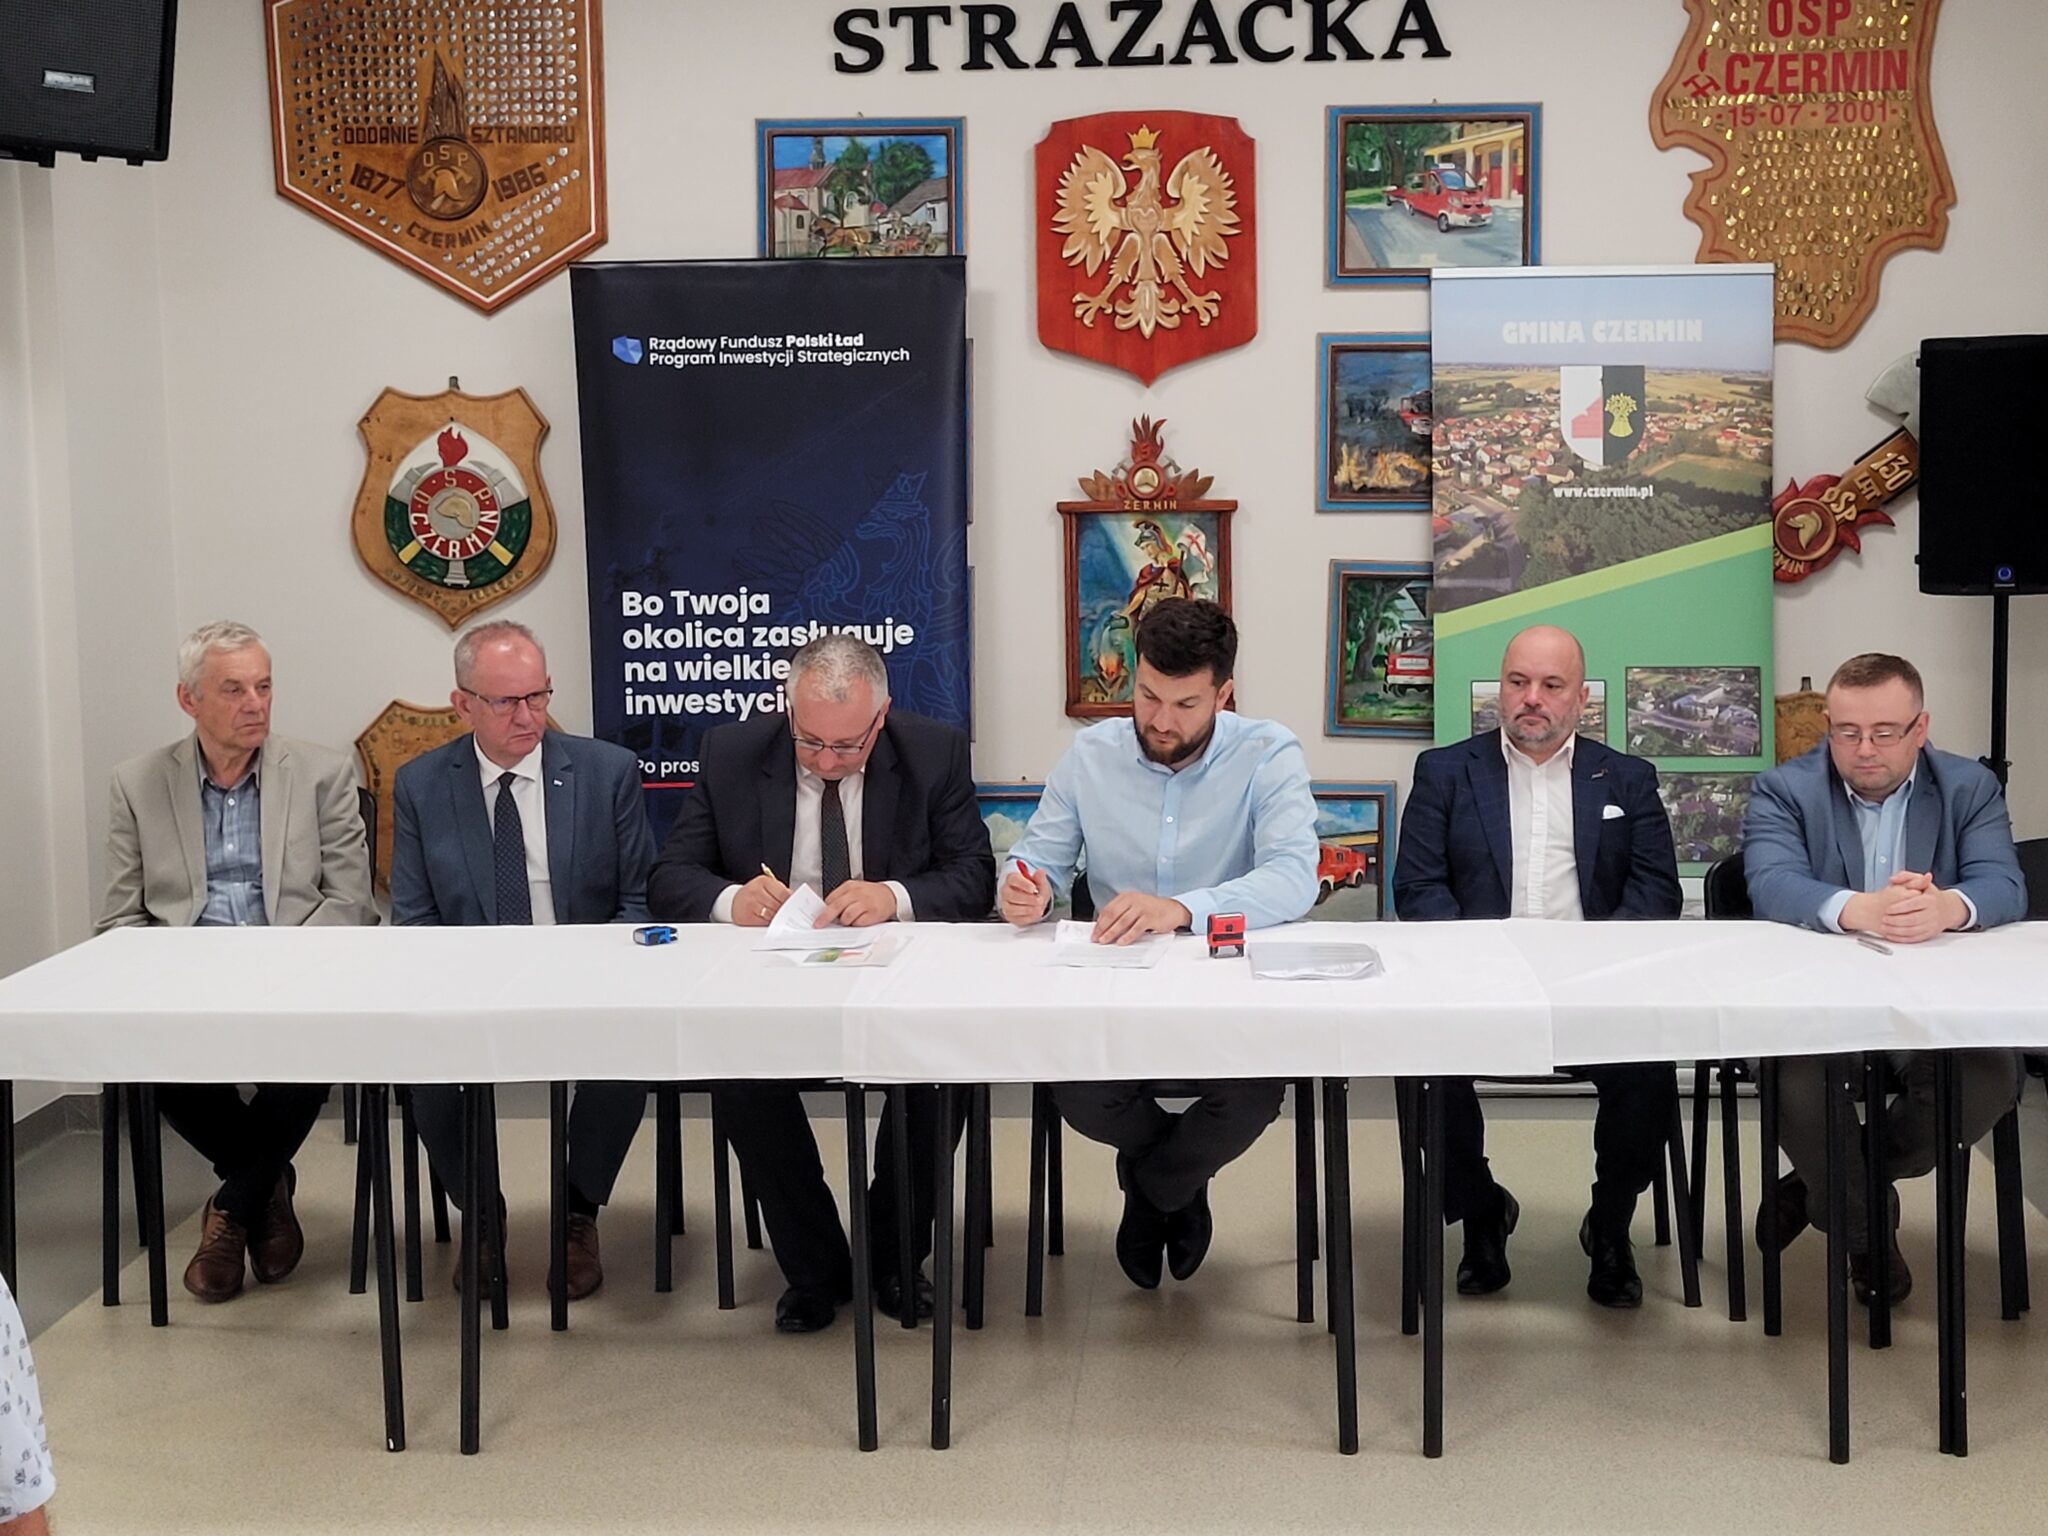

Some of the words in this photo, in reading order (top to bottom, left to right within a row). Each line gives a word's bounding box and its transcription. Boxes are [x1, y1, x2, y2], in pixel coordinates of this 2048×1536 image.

[1767, 0, 1851, 37] OSP
[1725, 50, 1908, 96] CZERMIN
[343, 126, 419, 144] ODDANIE
[471, 126, 576, 144] SZTANDARU
[423, 145, 469, 167] OSP
[350, 162, 406, 200] 1877
[491, 162, 548, 202] 1986
[406, 219, 493, 249] CZERMIN
[650, 336, 717, 352] Rządowy
[720, 335, 783, 349] Fundusz
[785, 333, 833, 348] Polski
[834, 333, 864, 347] Ład
[1502, 320, 1585, 345] GMINA
[1592, 319, 1703, 343] CZERMIN
[650, 352, 716, 368] Program
[719, 349, 794, 367] Inwestycji
[797, 347, 910, 366] Strategicznych
[1869, 452, 1913, 491] 130
[1553, 484, 1654, 499] www.czermin.pl
[1819, 486, 1858, 522] OSP
[410, 511, 499, 558] CZERMIN
[622, 591, 664, 617] Bo
[670, 586, 770, 623] Twoja
[622, 620, 745, 649] okolica
[624, 661, 667, 682] na
[674, 652, 791, 681] wielkie
